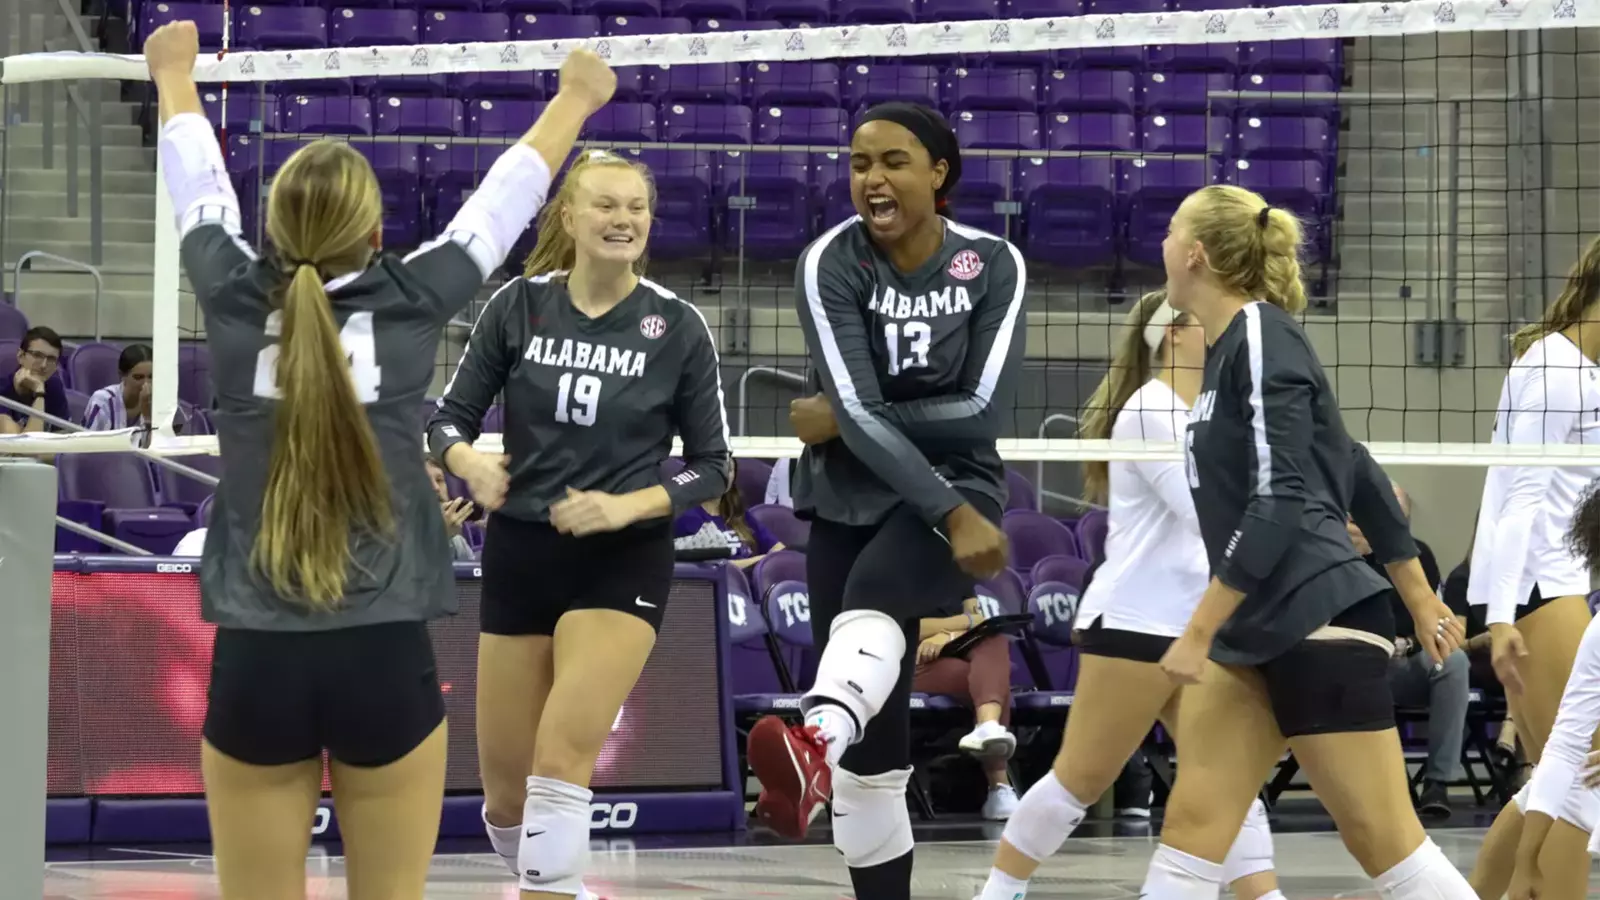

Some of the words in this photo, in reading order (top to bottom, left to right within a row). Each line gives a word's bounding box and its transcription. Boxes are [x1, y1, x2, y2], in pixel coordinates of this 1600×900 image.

[952, 250, 980, 273] SEC
[641, 316, 665, 337] SEC
[524, 335, 647, 377] ALABAMA
[884, 321, 931, 376] 13
[555, 372, 602, 427] 19
[157, 563, 191, 573] GEICO
[777, 592, 811, 628] TC
